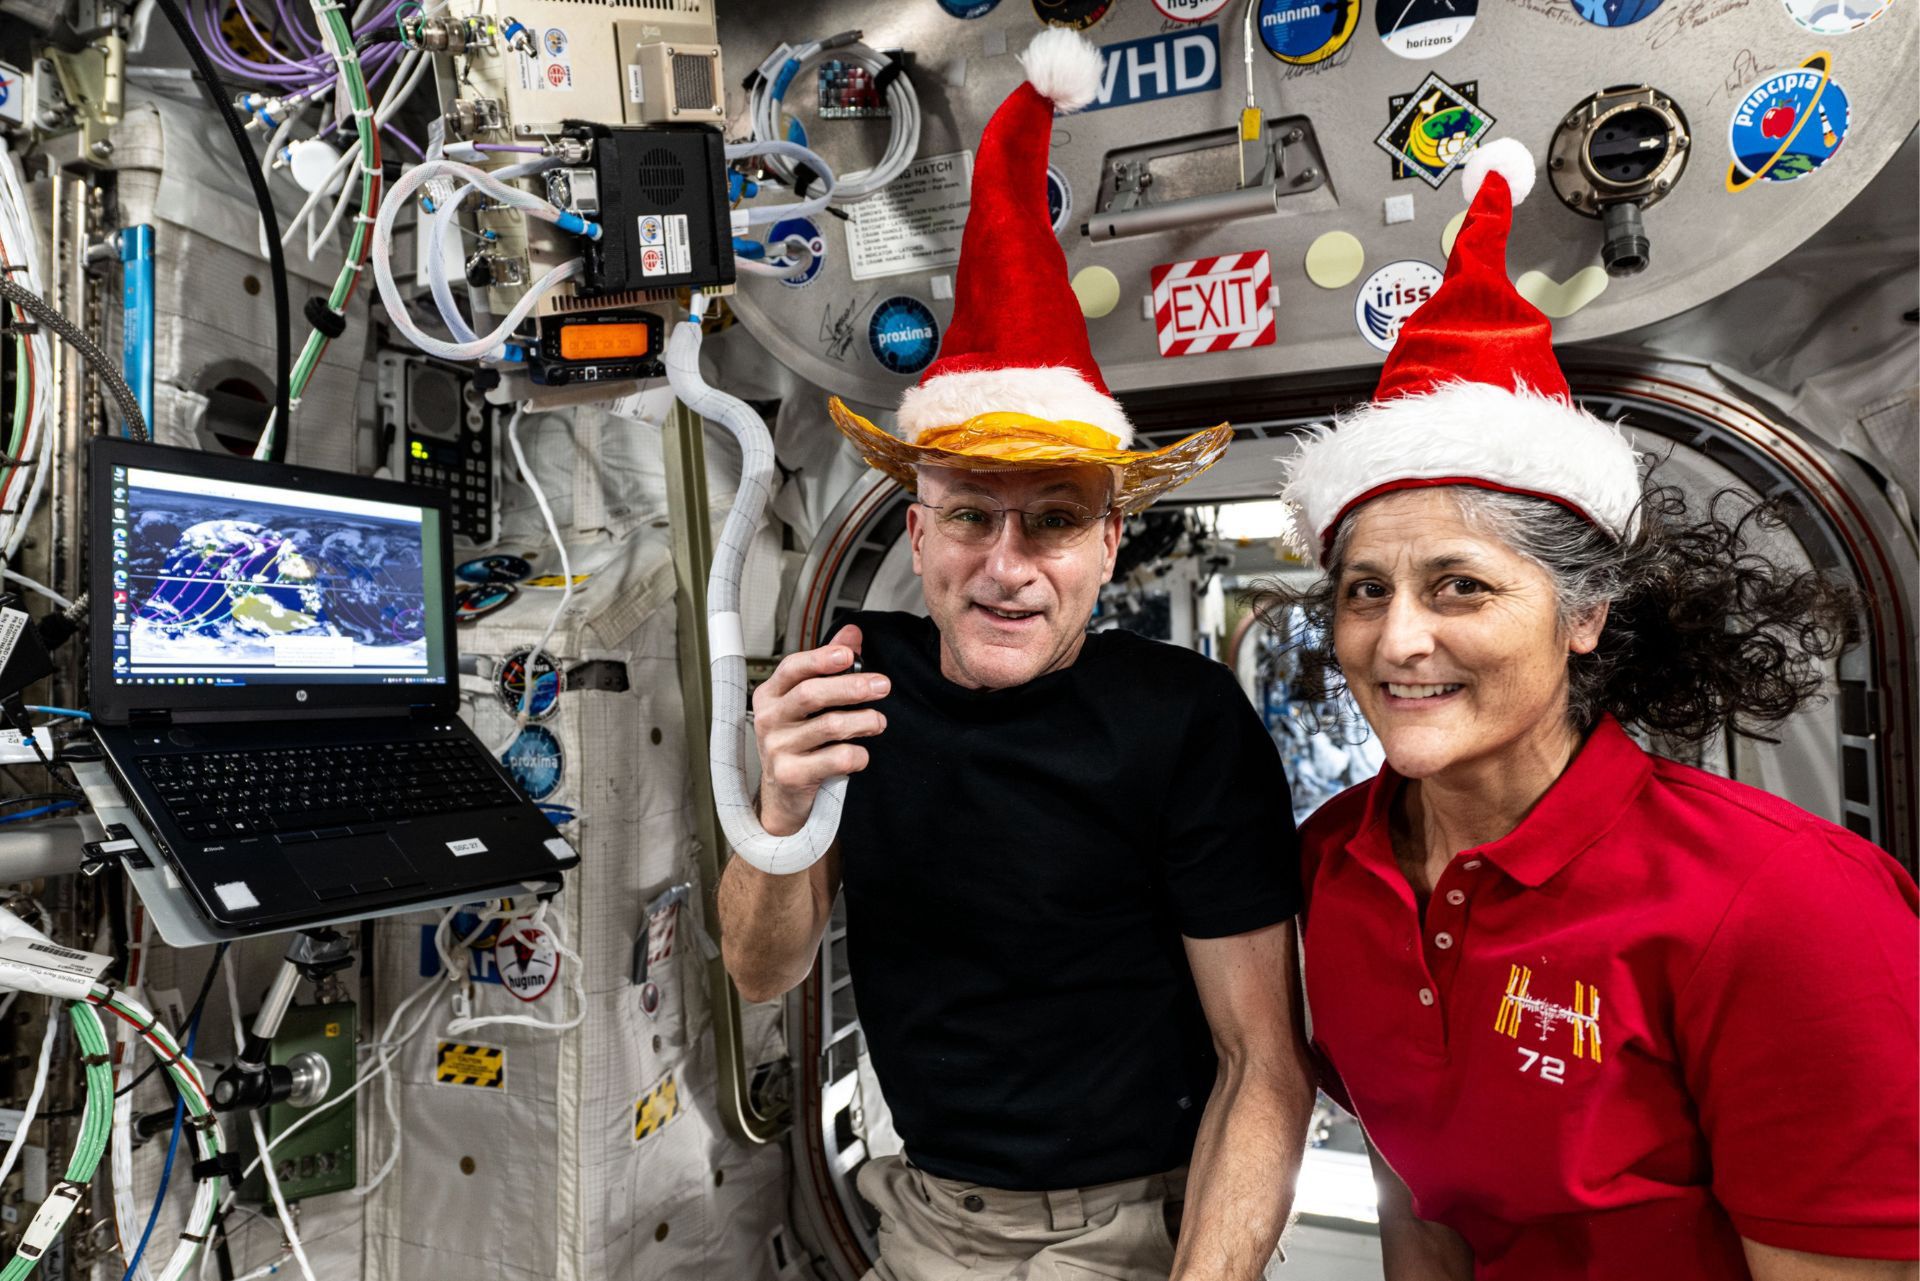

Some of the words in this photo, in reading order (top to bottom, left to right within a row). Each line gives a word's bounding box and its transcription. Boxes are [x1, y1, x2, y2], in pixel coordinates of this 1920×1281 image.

[1262, 4, 1321, 27] muninn
[1406, 34, 1453, 49] horizons
[1097, 34, 1217, 104] VHD
[1735, 74, 1819, 127] principia
[914, 162, 953, 176] HATCH
[1172, 276, 1252, 333] EXIT
[1376, 283, 1431, 308] iriss
[878, 326, 933, 348] proxima
[510, 752, 558, 770] proxima
[508, 974, 546, 990] huginn
